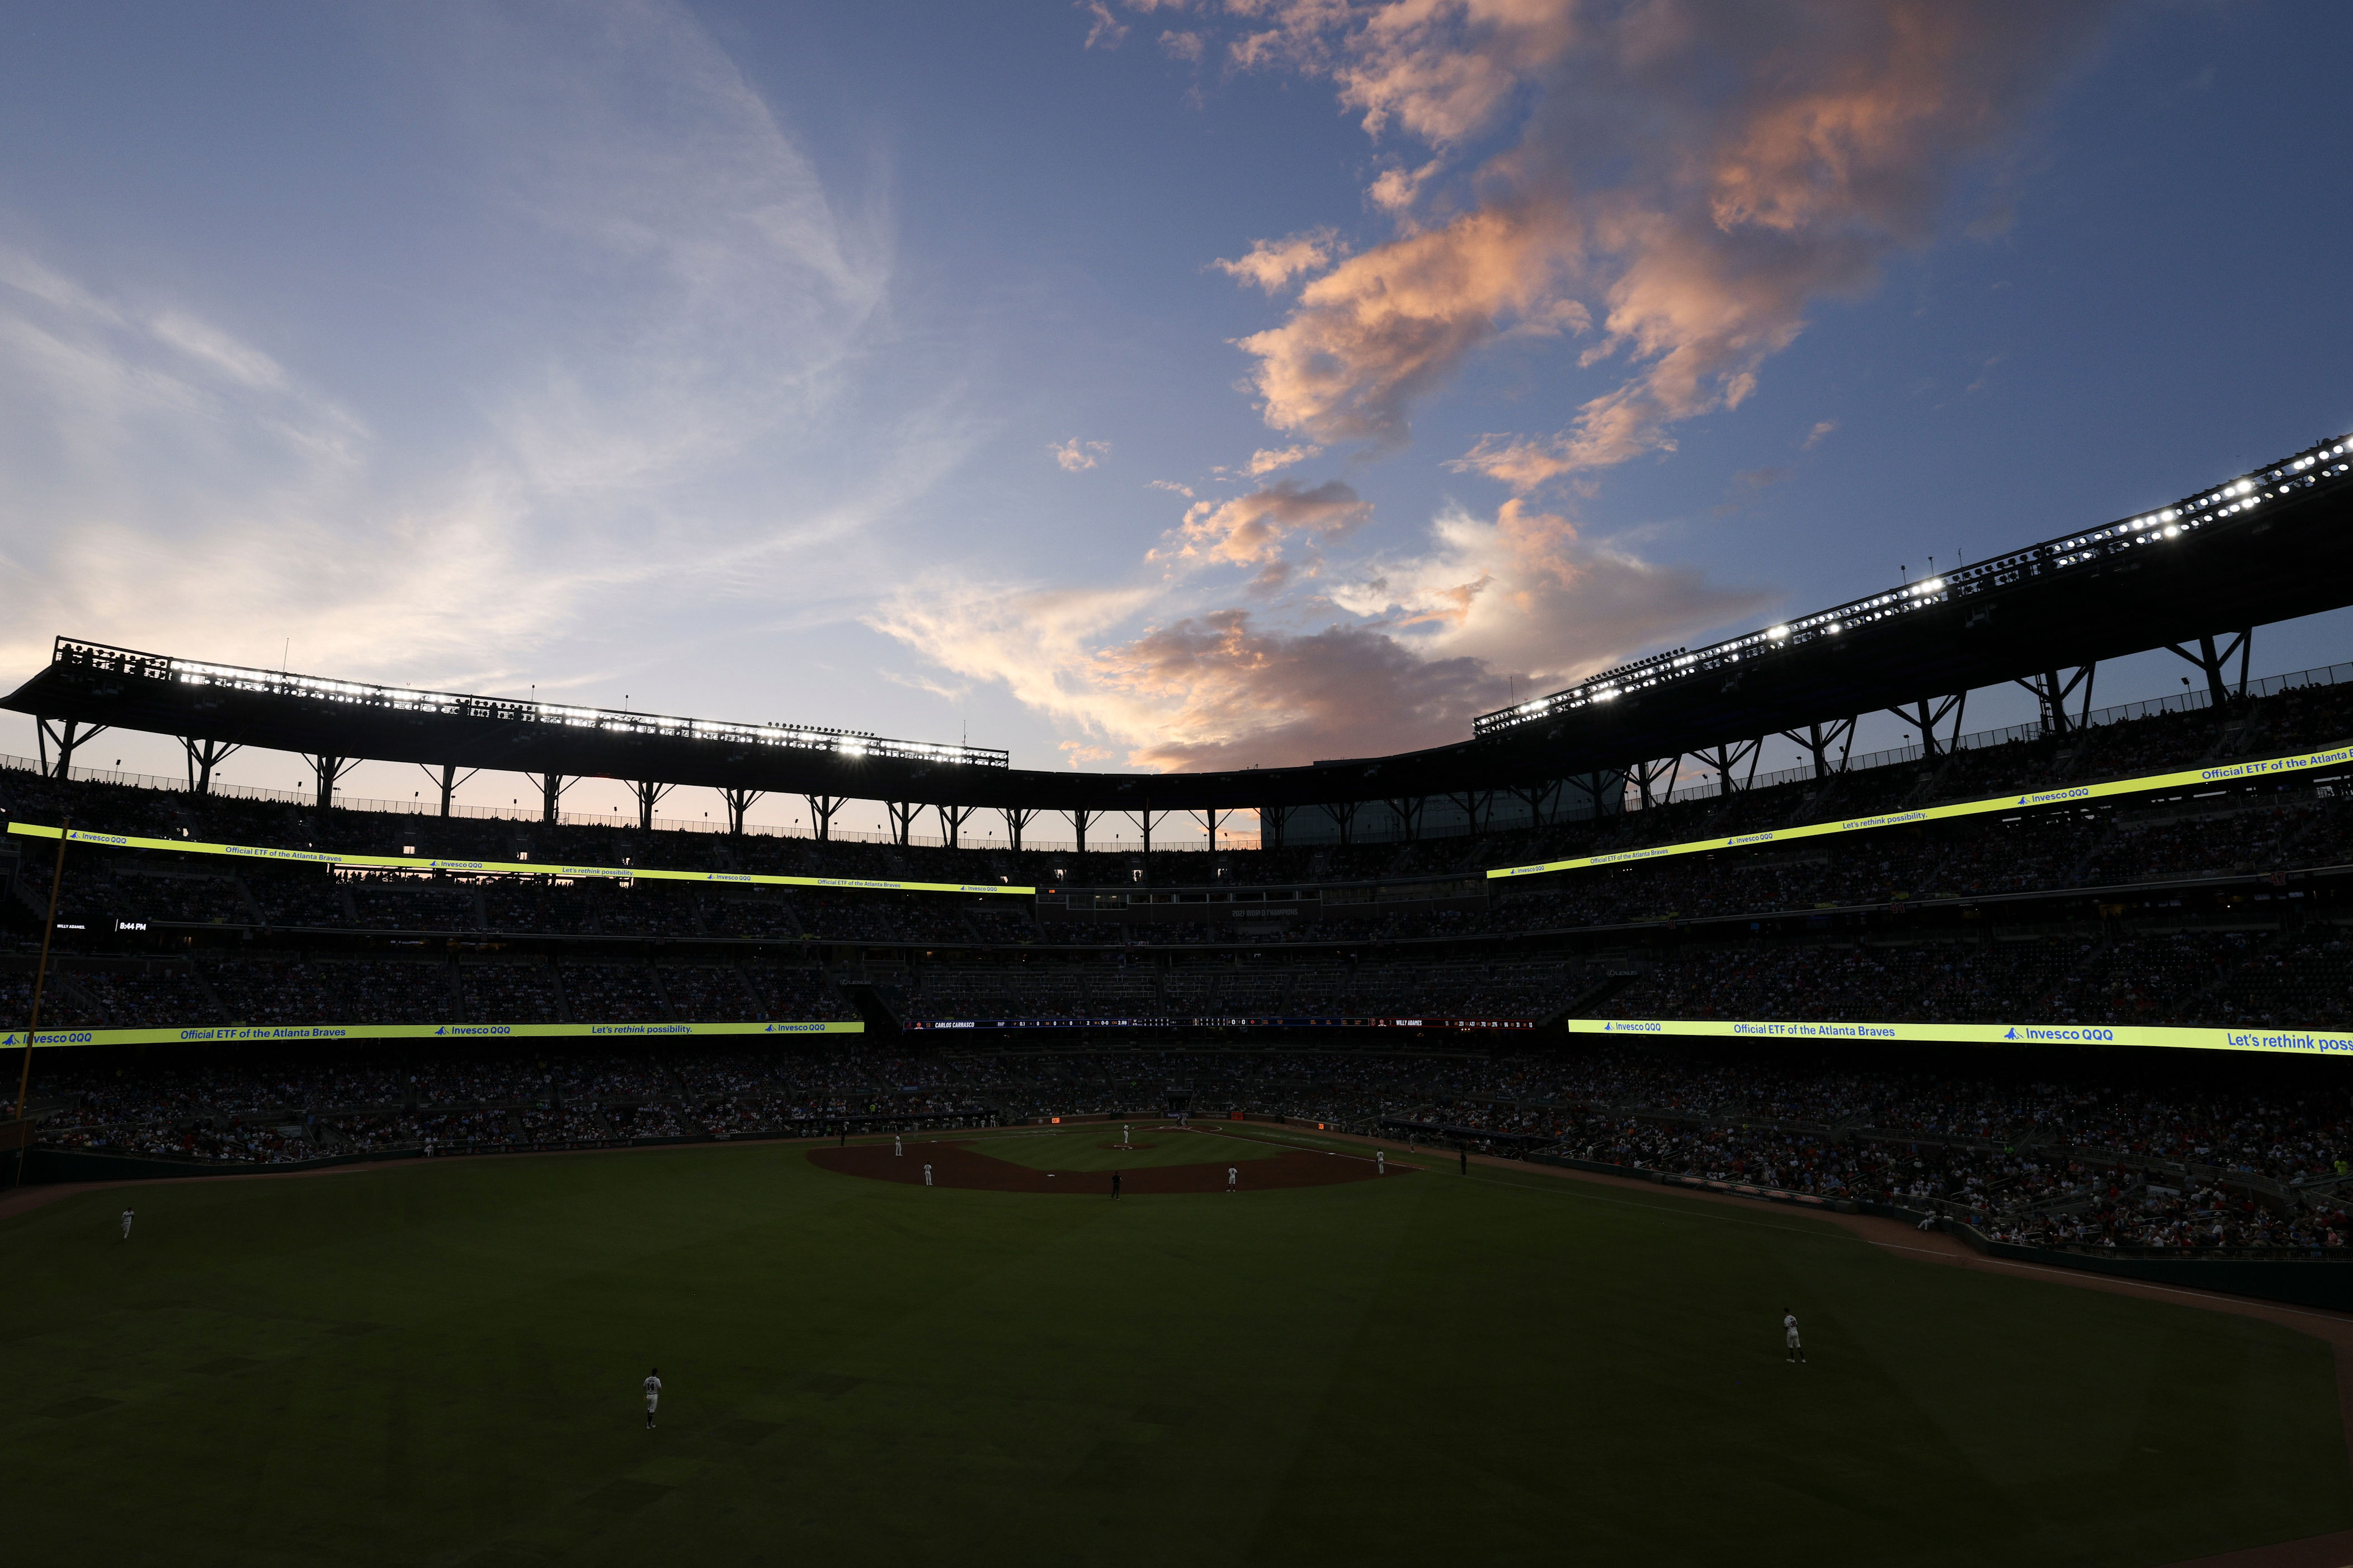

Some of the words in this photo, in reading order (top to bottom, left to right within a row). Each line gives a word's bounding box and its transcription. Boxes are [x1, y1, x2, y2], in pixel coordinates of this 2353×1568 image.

[2201, 766, 2244, 780] Official
[2246, 763, 2267, 774] ETF
[2270, 760, 2283, 771] of
[2285, 759, 2307, 768] the
[2310, 752, 2348, 764] Atlanta
[2032, 792, 2068, 802] Invesco
[2068, 788, 2089, 797] QQQ
[1860, 818, 1885, 826] rethink
[1887, 813, 1927, 824] possibility.
[82, 832, 110, 843] Invesco
[2269, 871, 2286, 886] 47
[1889, 902, 1906, 913] 44
[451, 1026, 489, 1035] Invesco
[490, 1026, 511, 1035] QQQ
[647, 1025, 692, 1034] possibility.
[1616, 1023, 1643, 1031] Invesco
[1645, 1023, 1662, 1032] QQQ
[1733, 1024, 1767, 1034] Official
[1768, 1024, 1785, 1035] ETF
[1788, 1024, 1798, 1035] of
[1799, 1025, 1817, 1035] the
[1818, 1025, 1856, 1036] Atlanta
[1857, 1026, 1896, 1037] Braves
[68, 1032, 93, 1043] QQQ
[180, 1029, 215, 1040] Official
[216, 1029, 238, 1038] ETF
[239, 1028, 251, 1038] of
[253, 1029, 271, 1038] the
[272, 1028, 310, 1037] Atlanta
[312, 1028, 346, 1037] Braves
[2025, 1028, 2080, 1040] Invesco
[2081, 1028, 2114, 1041] QQQ
[2262, 1033, 2316, 1049] rethink
